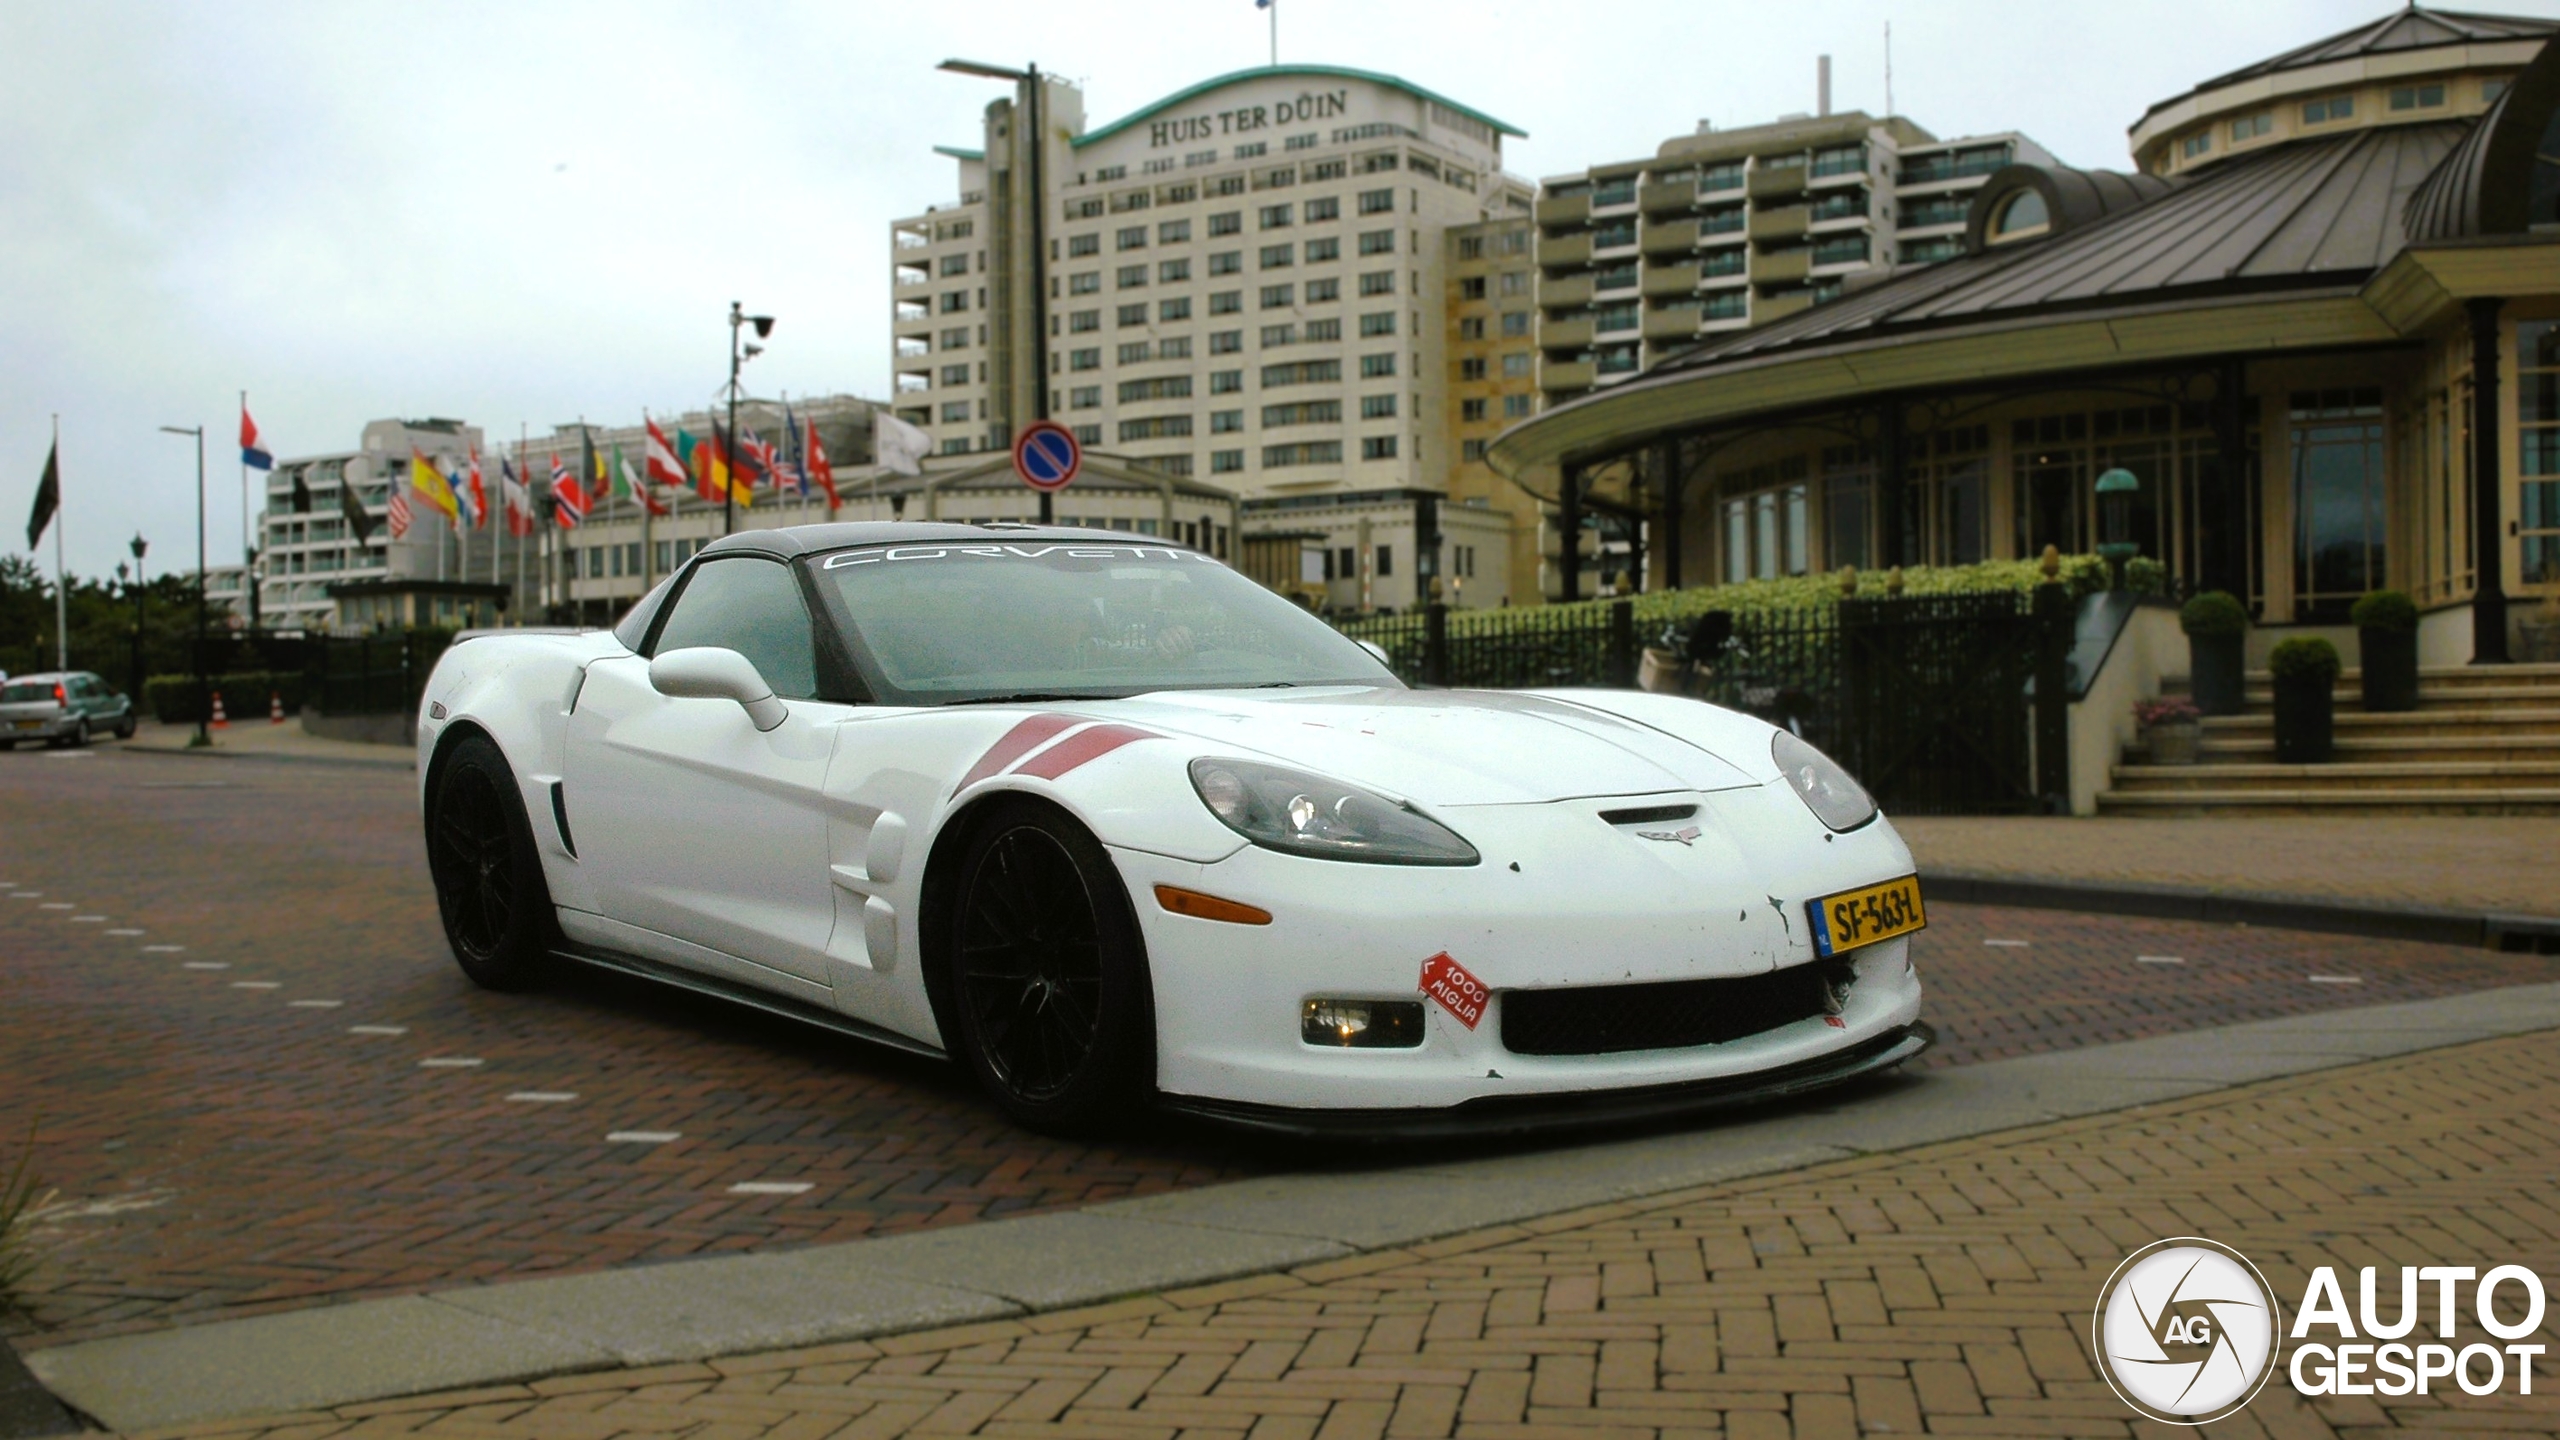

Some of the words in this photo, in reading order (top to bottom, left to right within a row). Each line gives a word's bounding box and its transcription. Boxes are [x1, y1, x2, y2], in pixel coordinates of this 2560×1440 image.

[1150, 115, 1212, 148] HUIS
[1218, 105, 1269, 134] TER
[1430, 979, 1478, 1022] MIGLIA
[1446, 966, 1485, 1003] 1000
